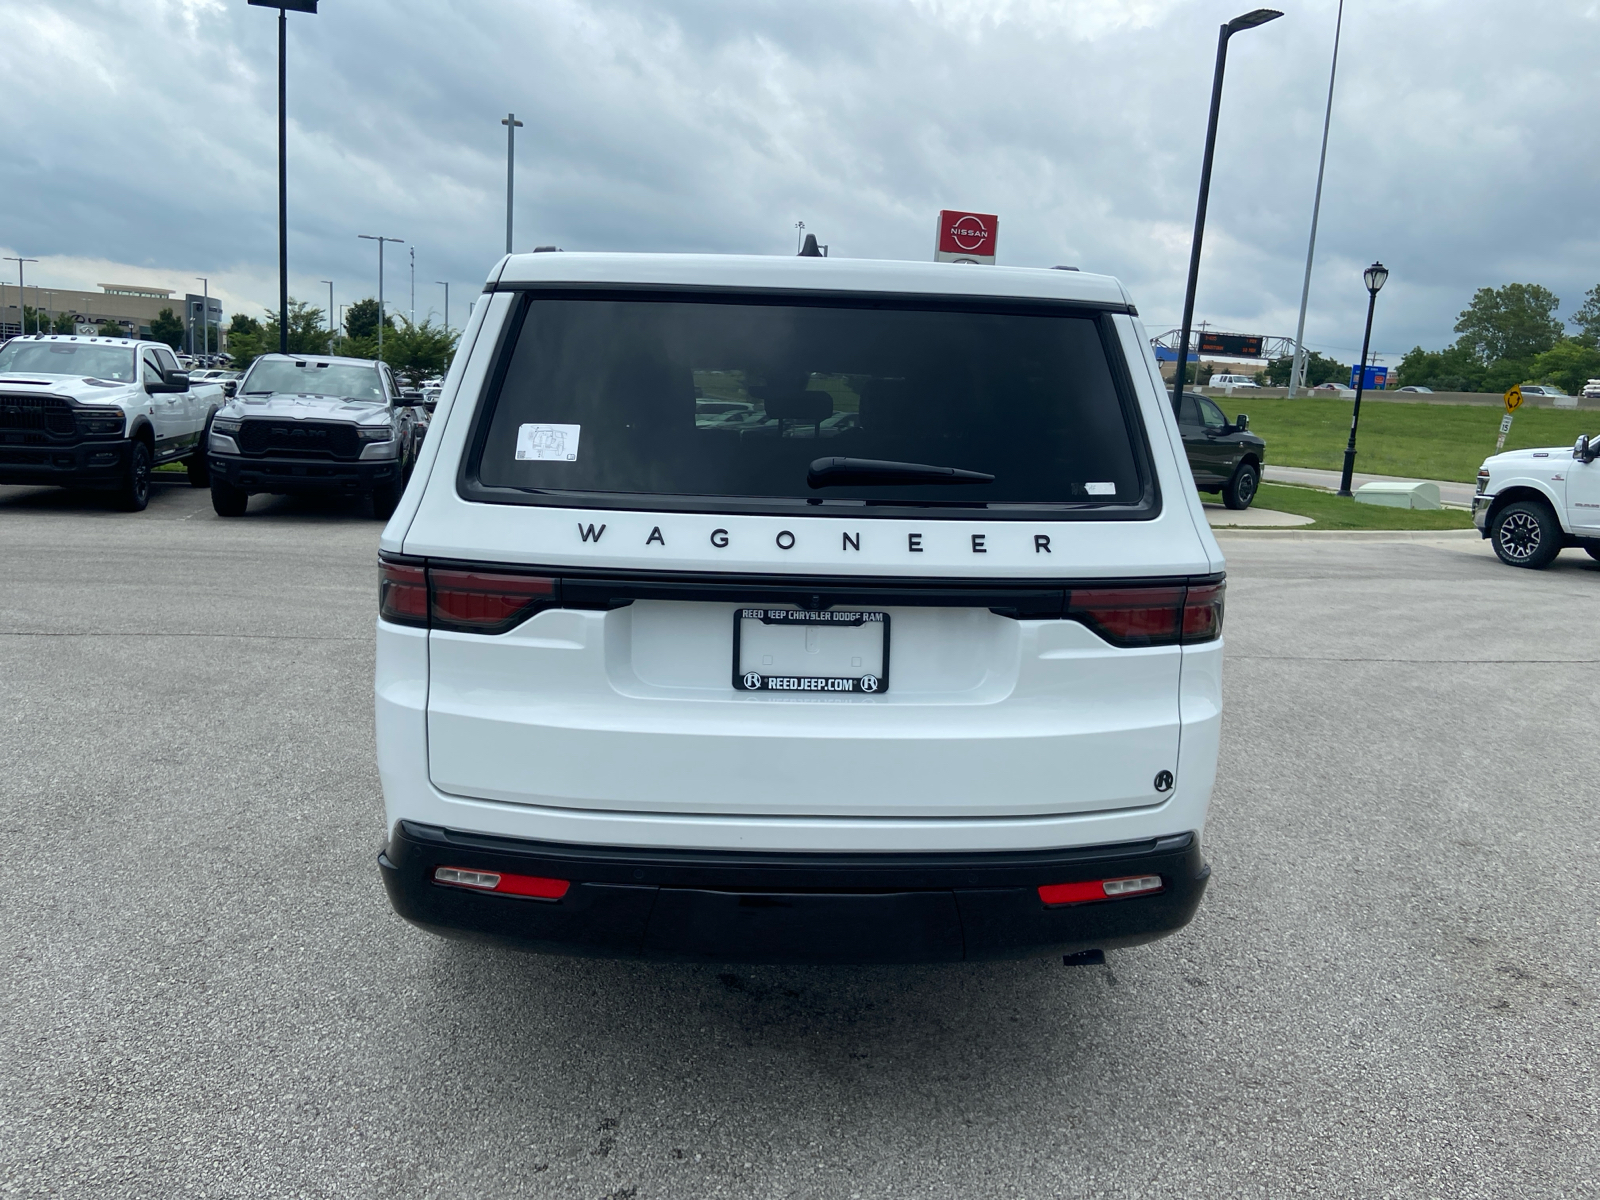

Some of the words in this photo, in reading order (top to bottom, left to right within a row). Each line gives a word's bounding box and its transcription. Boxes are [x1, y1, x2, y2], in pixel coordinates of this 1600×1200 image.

[951, 228, 988, 238] NISSAN
[271, 428, 326, 437] RAM
[578, 522, 1052, 553] WAGONEER
[742, 609, 764, 618] REED
[788, 611, 831, 621] CHRYSLER
[863, 612, 883, 622] RAM
[768, 677, 853, 691] REEDJEEP.COM
